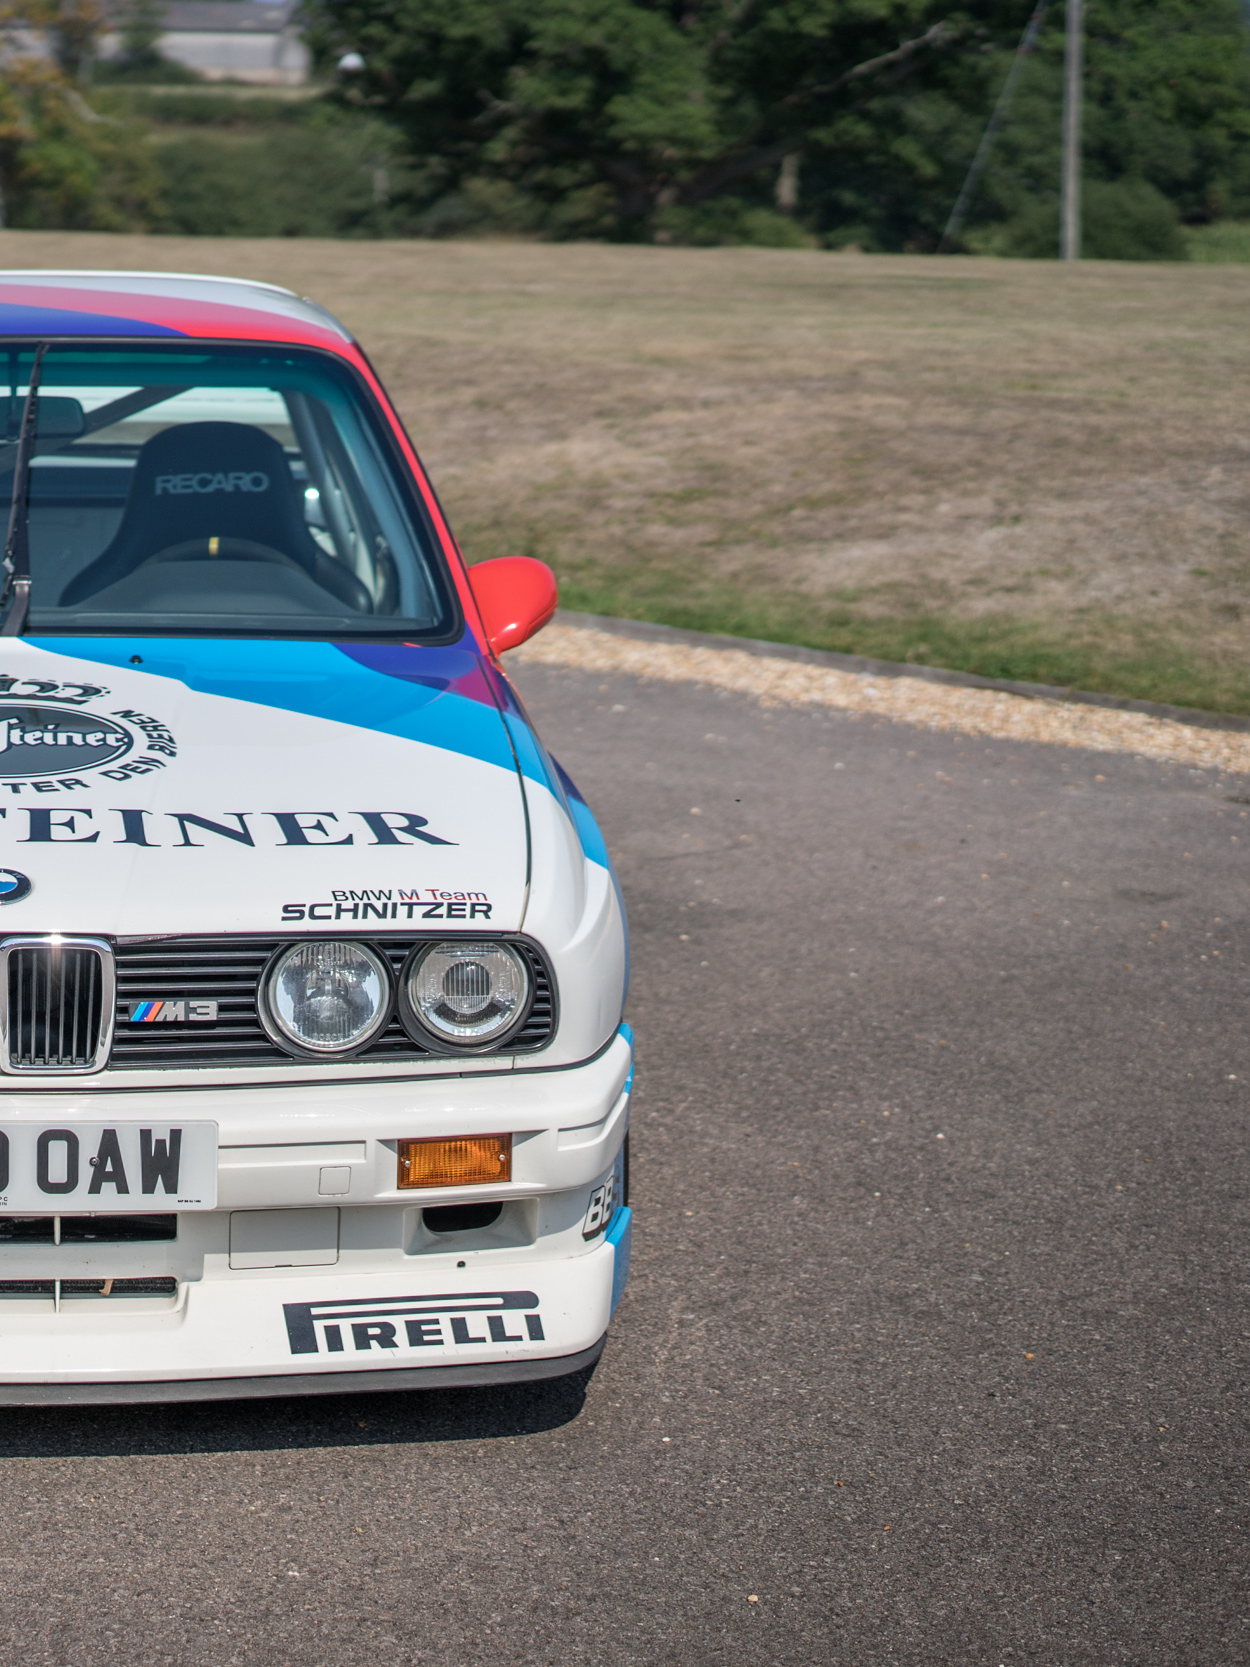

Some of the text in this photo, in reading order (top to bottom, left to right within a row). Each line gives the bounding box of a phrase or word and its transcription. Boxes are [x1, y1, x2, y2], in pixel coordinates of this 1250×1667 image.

[154, 471, 270, 496] RECARO
[109, 709, 178, 758] BIEREN
[98, 755, 167, 782] DEN
[331, 889, 488, 902] BMW M Team
[281, 901, 493, 921] SCHNITZER
[154, 1001, 219, 1022] M3
[36, 1128, 183, 1195] OAW
[282, 1291, 546, 1355] PIRELLI
